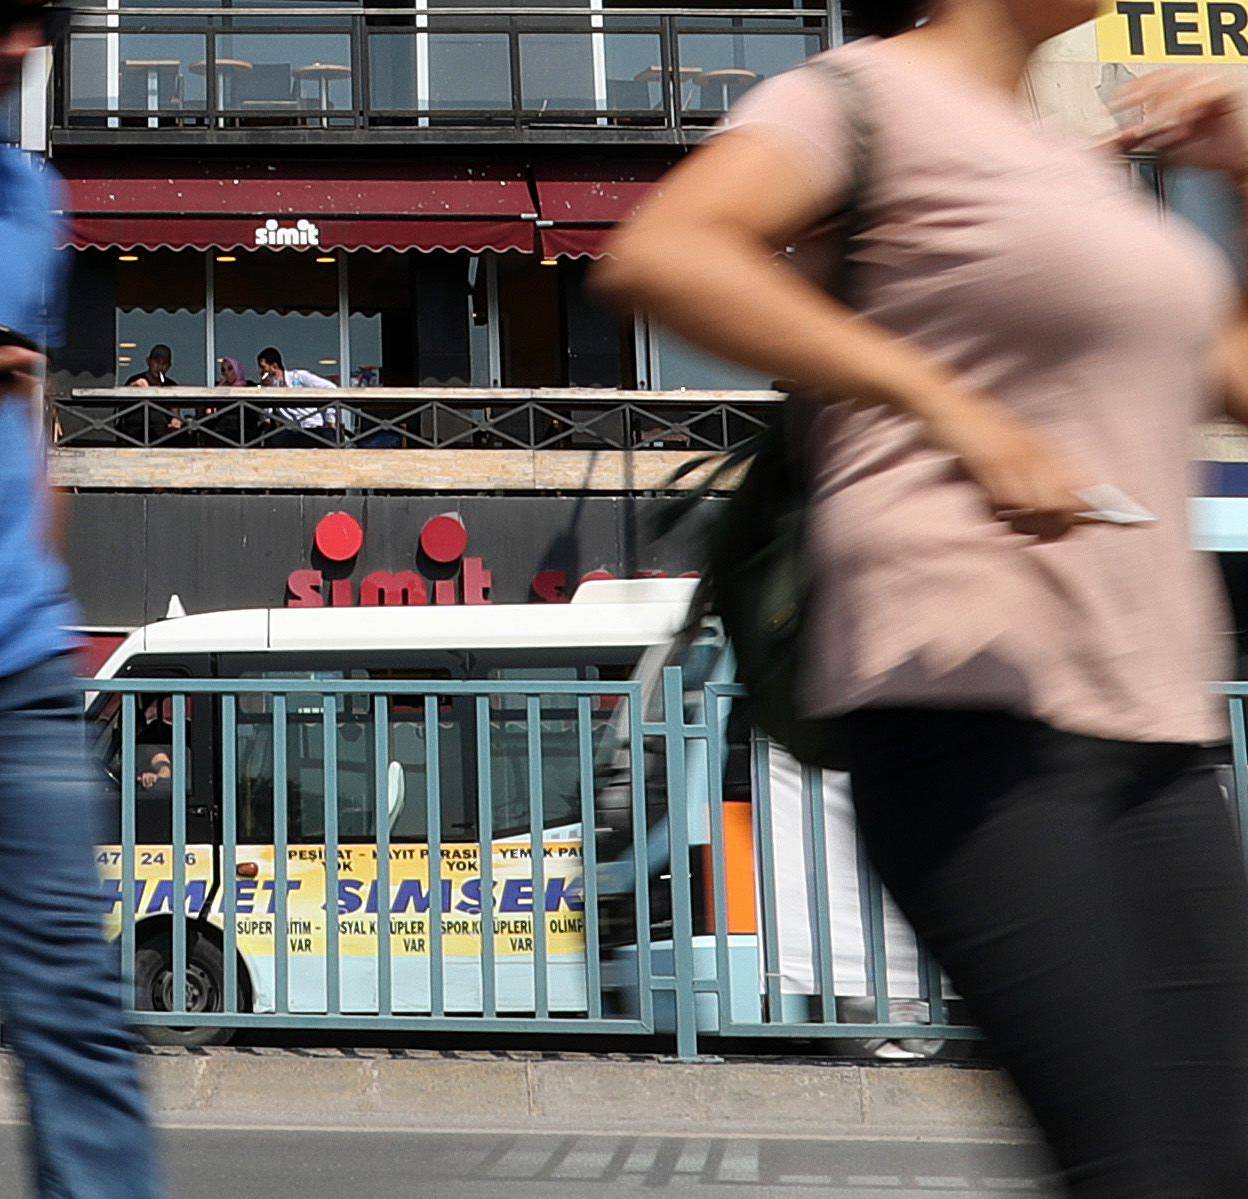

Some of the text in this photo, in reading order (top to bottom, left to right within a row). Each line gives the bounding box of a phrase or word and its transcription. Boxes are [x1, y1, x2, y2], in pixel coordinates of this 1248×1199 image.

[1116, 1, 1248, 56] TER
[255, 219, 319, 245] simit
[287, 511, 492, 607] simit
[141, 852, 165, 865] 24
[288, 847, 352, 862] PEŞİAT
[446, 861, 478, 871] YOK
[237, 917, 272, 935] SÜPER
[290, 939, 311, 952] VAR
[404, 938, 426, 952] VAR
[510, 937, 533, 951] VAR
